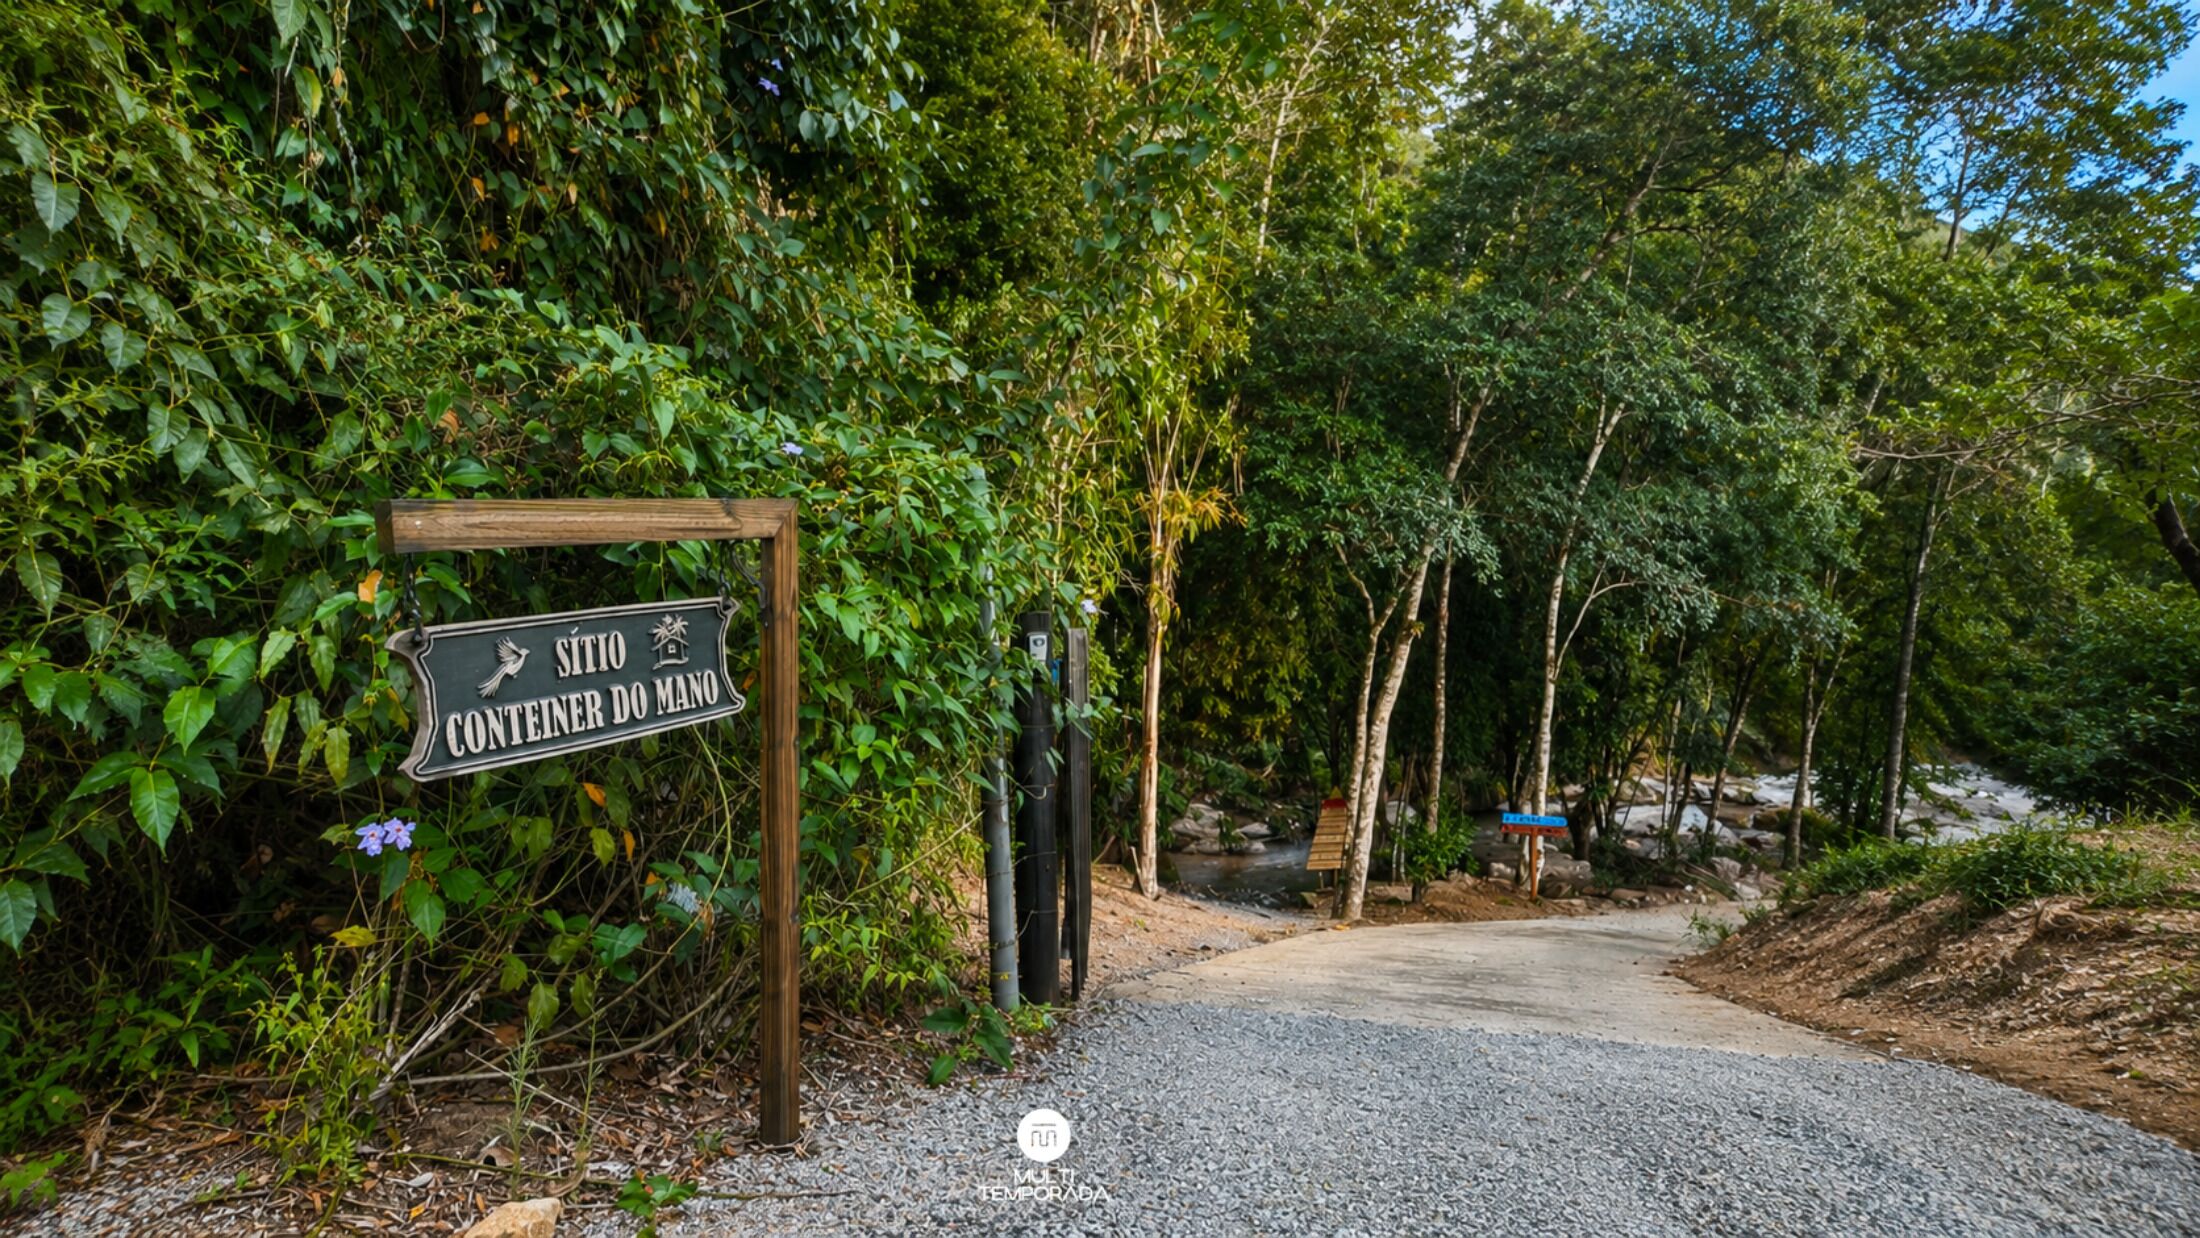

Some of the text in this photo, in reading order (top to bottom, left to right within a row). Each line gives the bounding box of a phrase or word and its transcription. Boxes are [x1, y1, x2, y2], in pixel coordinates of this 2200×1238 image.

[555, 626, 626, 678] SÍTIO
[446, 669, 719, 758] CONTEINER DO MANO
